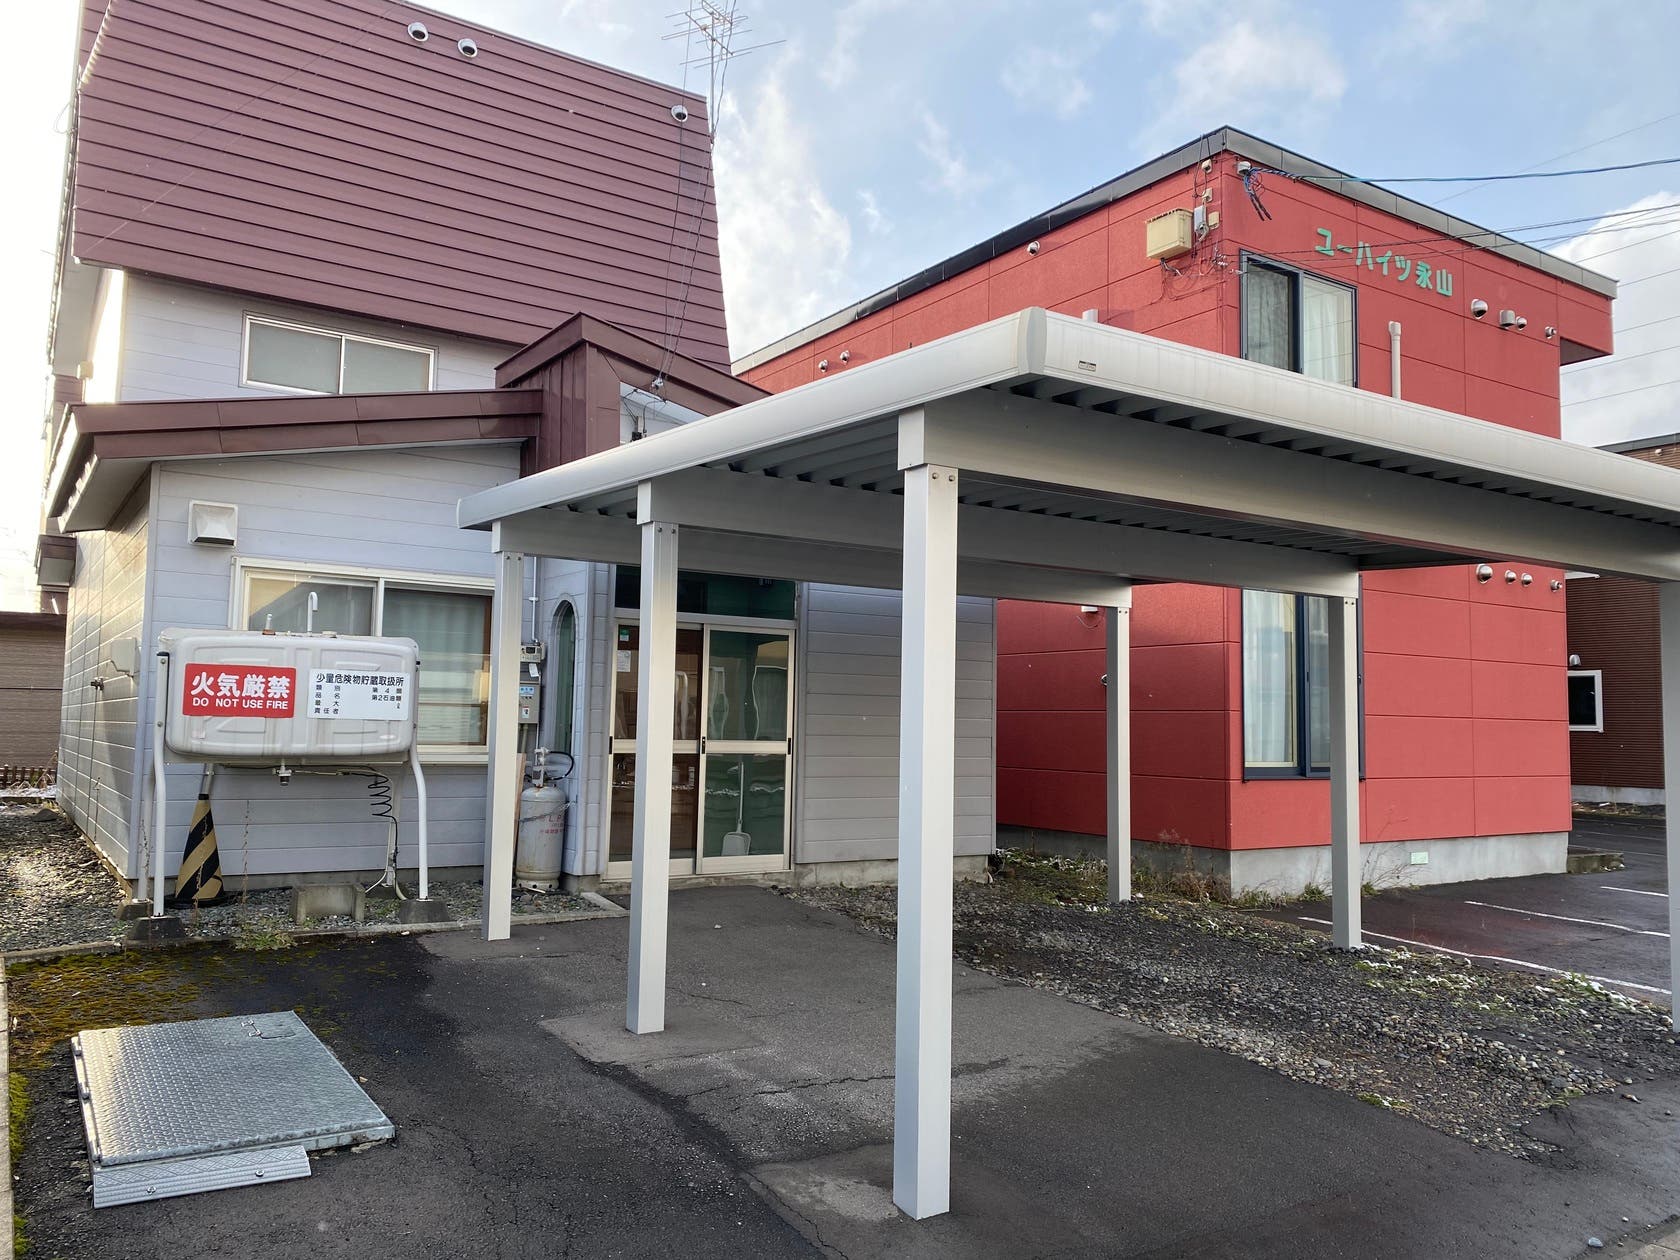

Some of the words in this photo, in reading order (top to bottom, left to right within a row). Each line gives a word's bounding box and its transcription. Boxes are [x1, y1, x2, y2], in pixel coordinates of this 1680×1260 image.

[1315, 227, 1453, 297] ユーハイツ永山
[191, 672, 290, 698] 火気厳禁
[316, 673, 404, 687] 少量危険物貯蔵取扱所
[192, 697, 209, 707] DO
[215, 698, 240, 708] NOT
[242, 699, 264, 709] USE
[266, 700, 289, 710] FIRE
